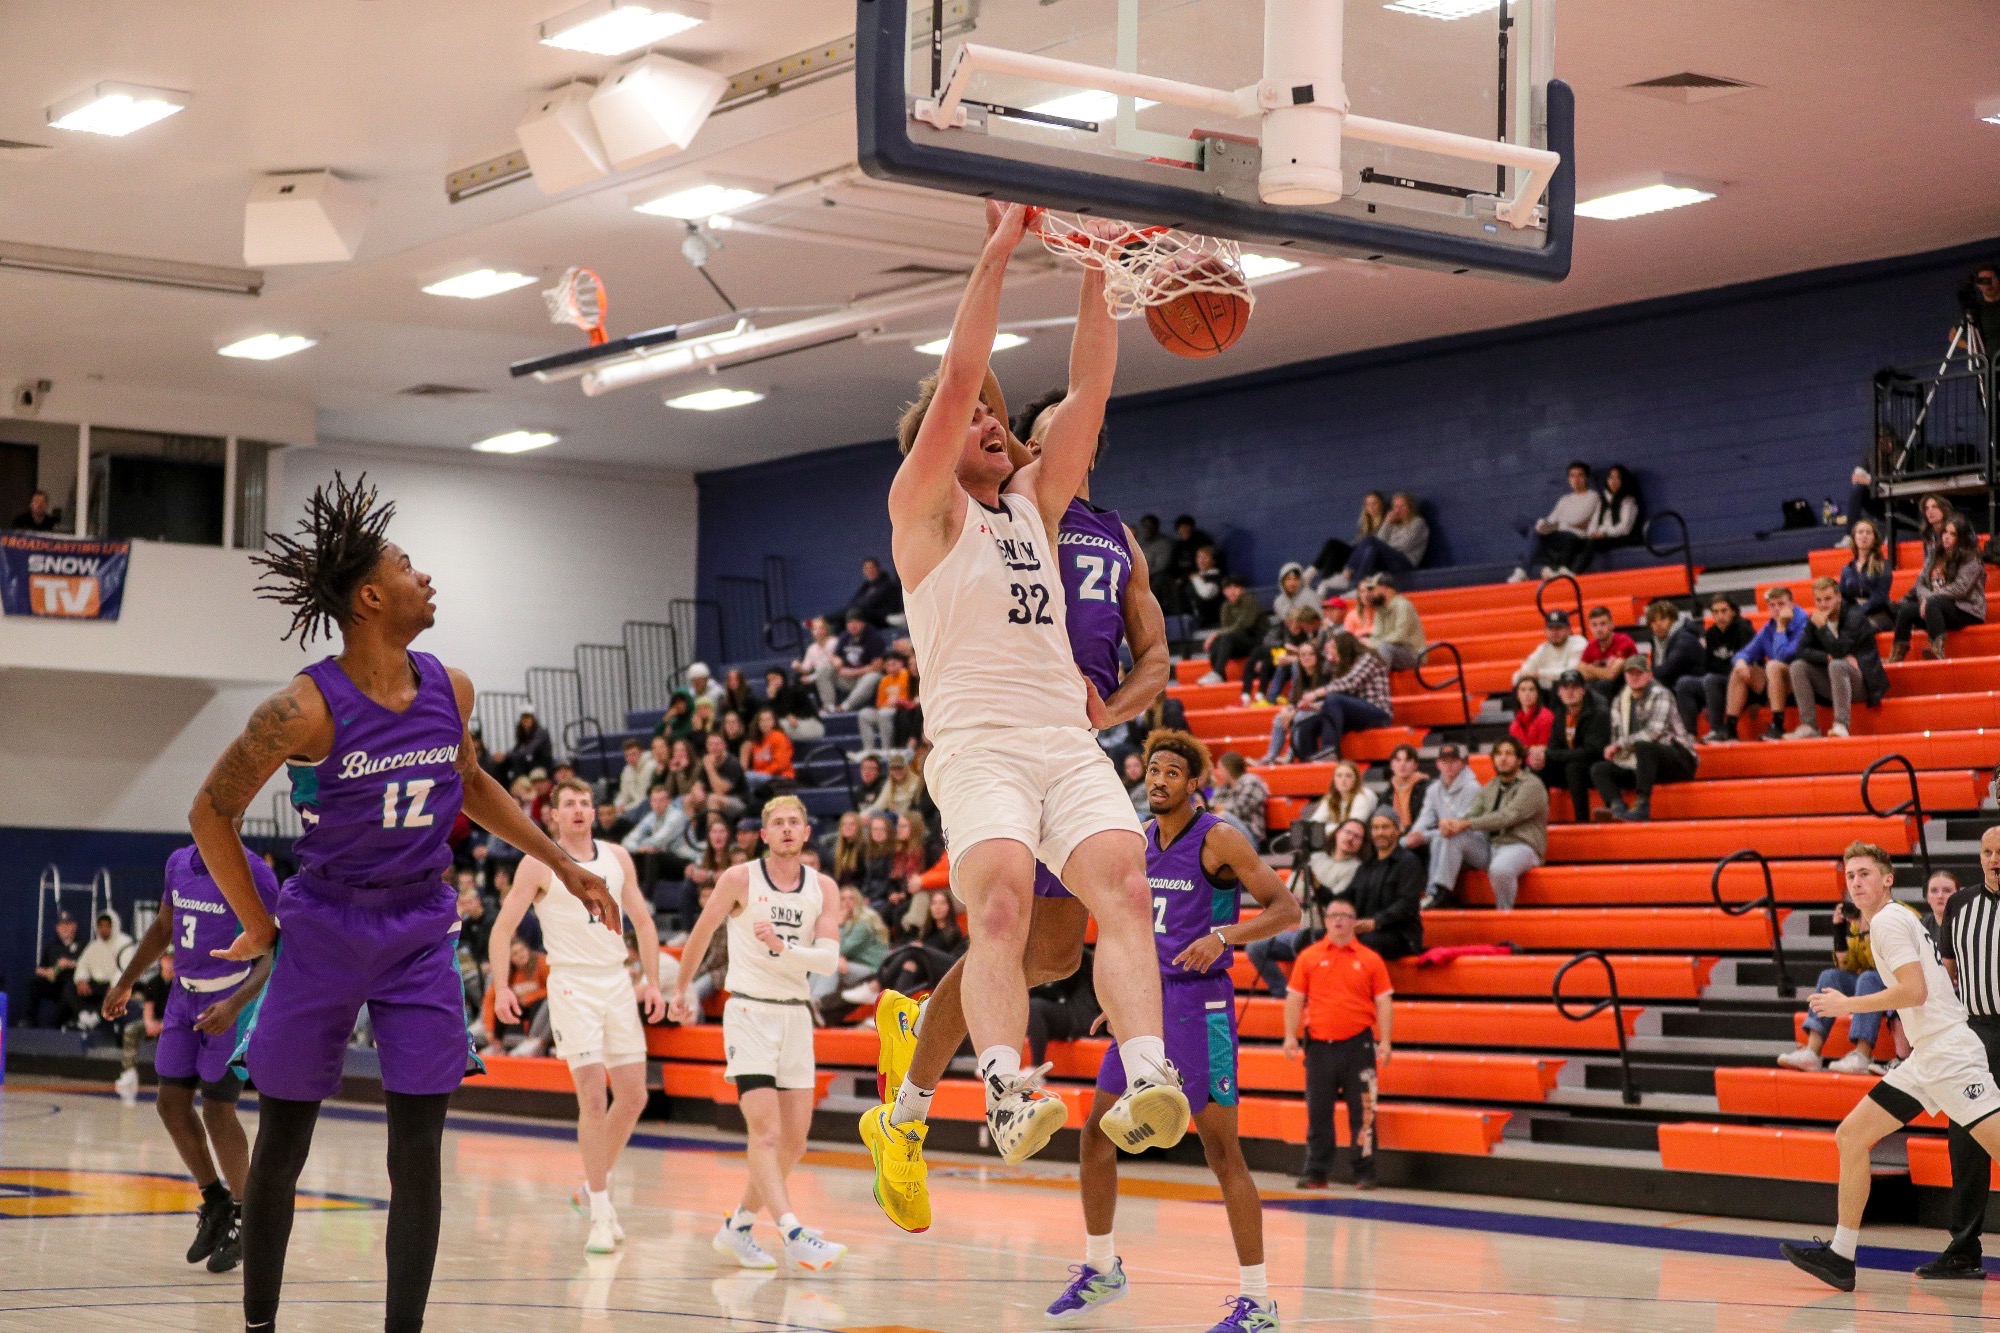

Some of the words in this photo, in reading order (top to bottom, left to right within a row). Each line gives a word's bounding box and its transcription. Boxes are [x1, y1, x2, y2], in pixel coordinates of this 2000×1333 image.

[28, 554, 101, 576] SNOW
[996, 538, 1036, 561] SNW
[33, 578, 93, 613] TV
[1076, 555, 1121, 603] 21
[1008, 583, 1053, 625] 32
[382, 778, 435, 829] 12
[172, 889, 226, 915] Buccaneers
[771, 906, 803, 922] SNOW
[181, 915, 197, 950] 3
